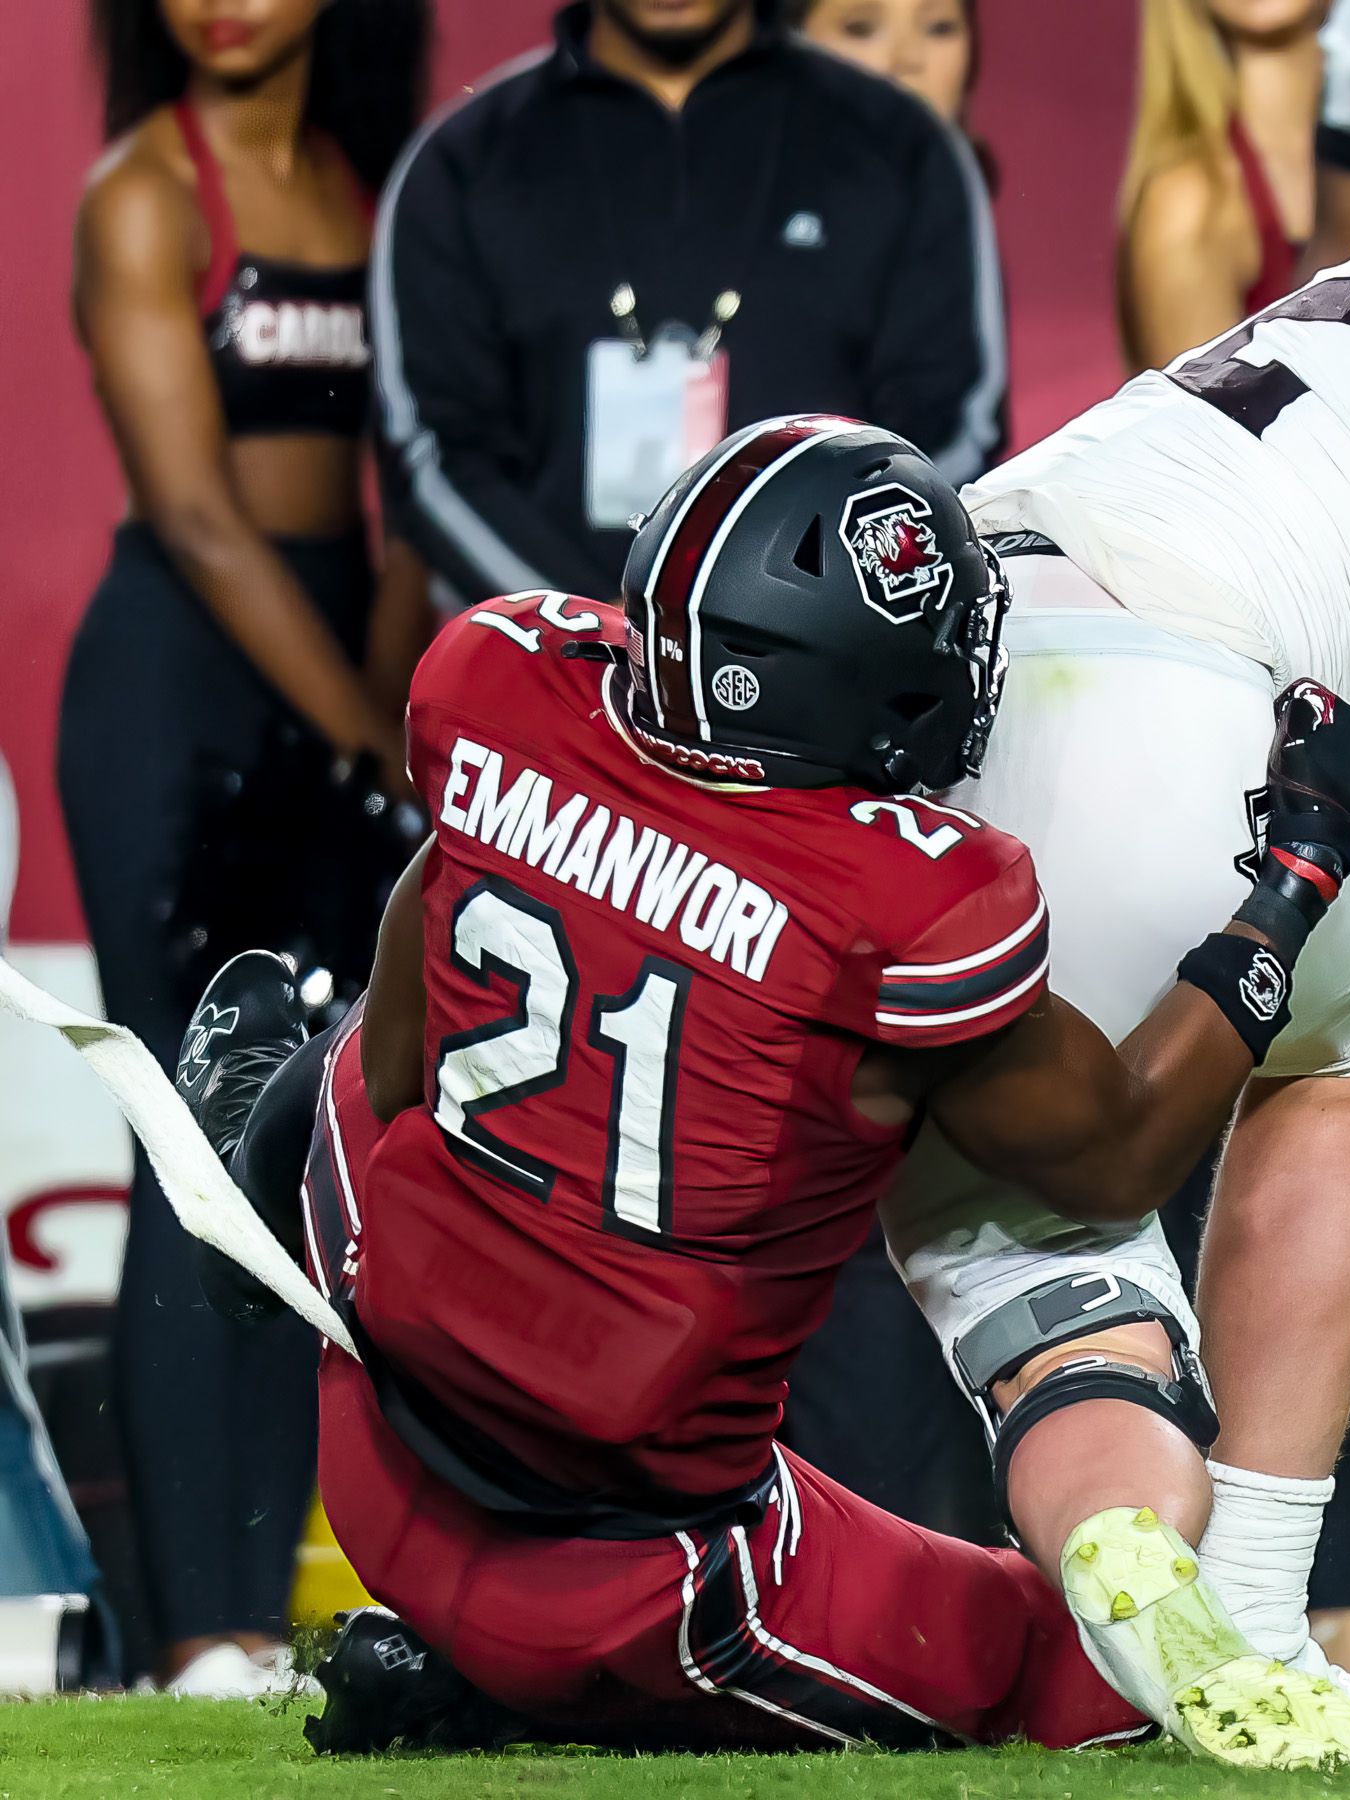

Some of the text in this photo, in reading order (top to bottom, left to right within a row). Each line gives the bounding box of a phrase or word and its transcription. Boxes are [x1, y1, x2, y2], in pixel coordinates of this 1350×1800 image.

[660, 636, 683, 662] 1%
[712, 665, 760, 710] SEC
[440, 736, 788, 983] EMMANWORI
[430, 876, 692, 1248] 21
